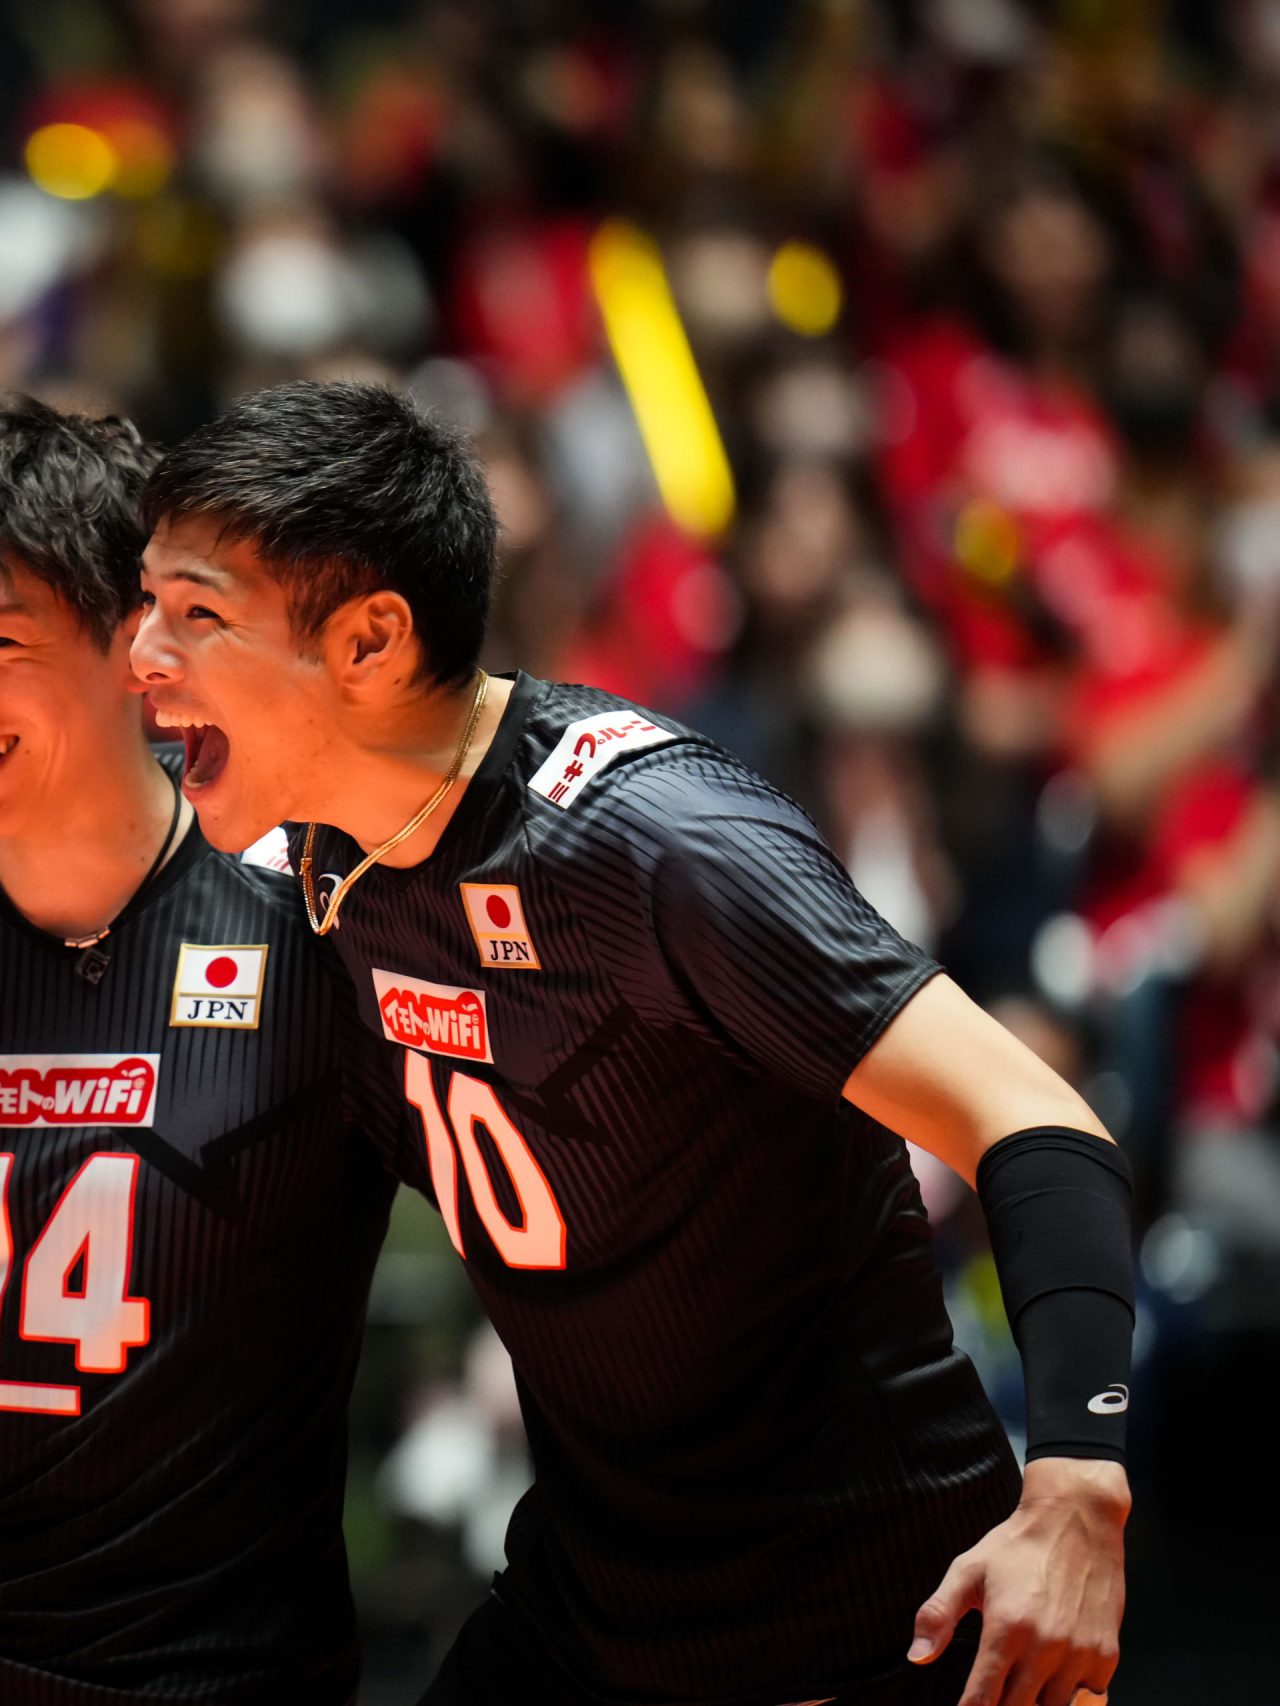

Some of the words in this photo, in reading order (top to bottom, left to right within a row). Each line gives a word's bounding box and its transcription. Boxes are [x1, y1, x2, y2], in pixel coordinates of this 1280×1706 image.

[489, 940, 530, 961] JPN
[187, 1000, 248, 1020] JPN
[404, 1049, 567, 1270] 10
